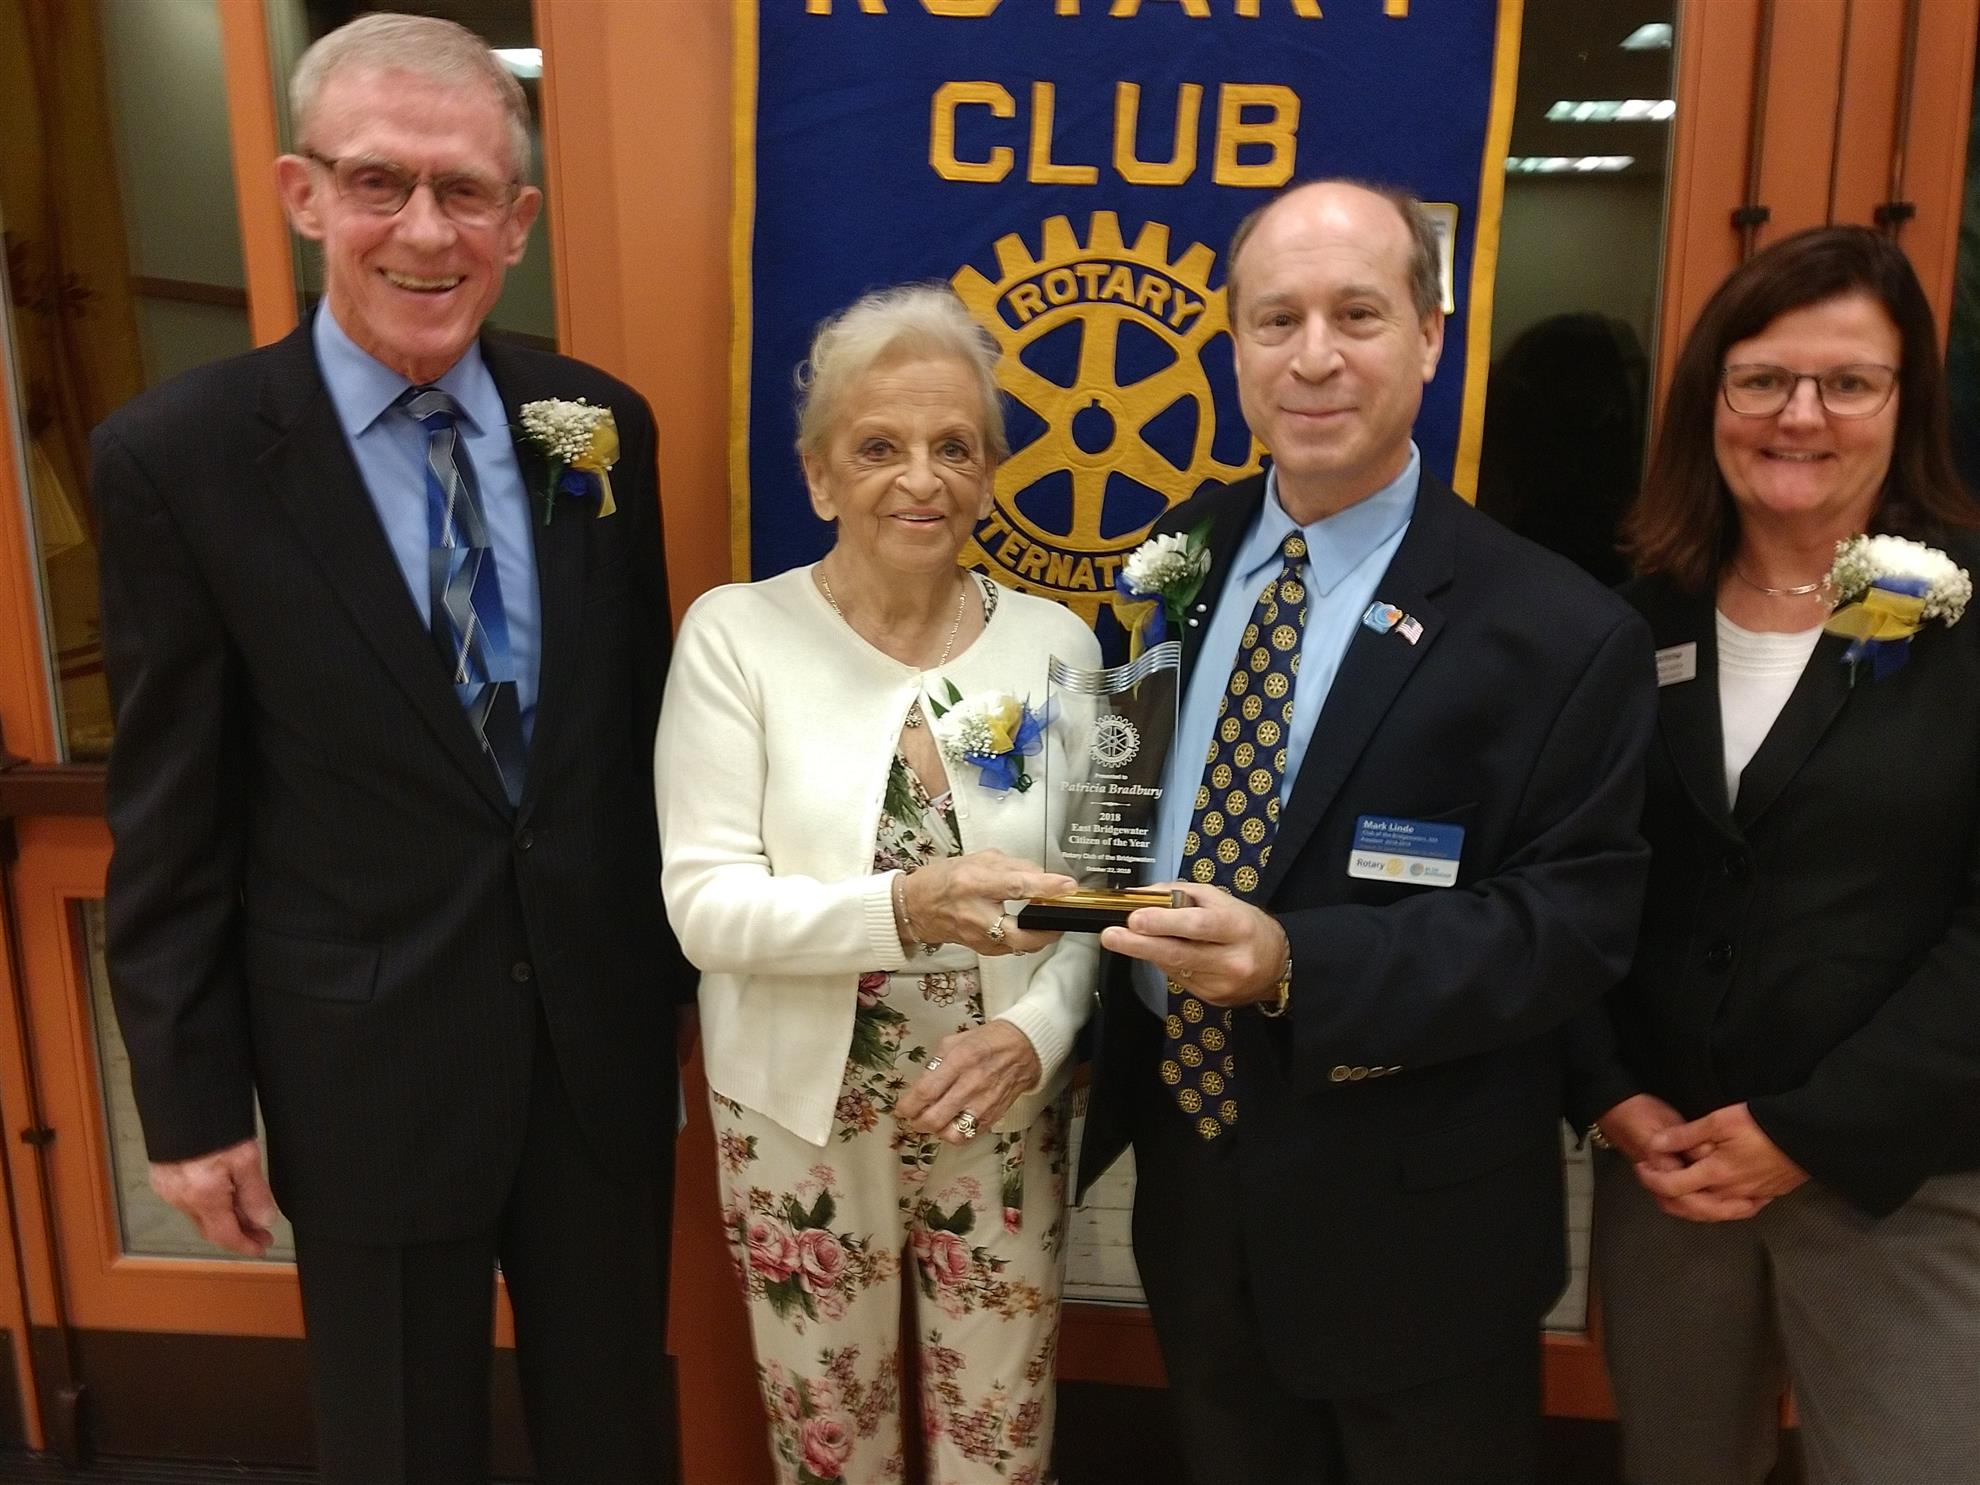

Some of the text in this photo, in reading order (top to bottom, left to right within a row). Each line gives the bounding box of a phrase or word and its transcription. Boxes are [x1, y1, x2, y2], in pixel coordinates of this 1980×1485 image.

[929, 81, 1301, 187] CLUB
[1007, 263, 1206, 328] ROTARY
[1060, 781, 1163, 799] Patricia Bradbury
[1098, 812, 1121, 822] 2018
[1071, 823, 1149, 836] East Bridgewater
[1363, 820, 1415, 833] Mark Linde
[1068, 835, 1151, 848] Citizen of the Year
[1356, 858, 1385, 870] Rotary
